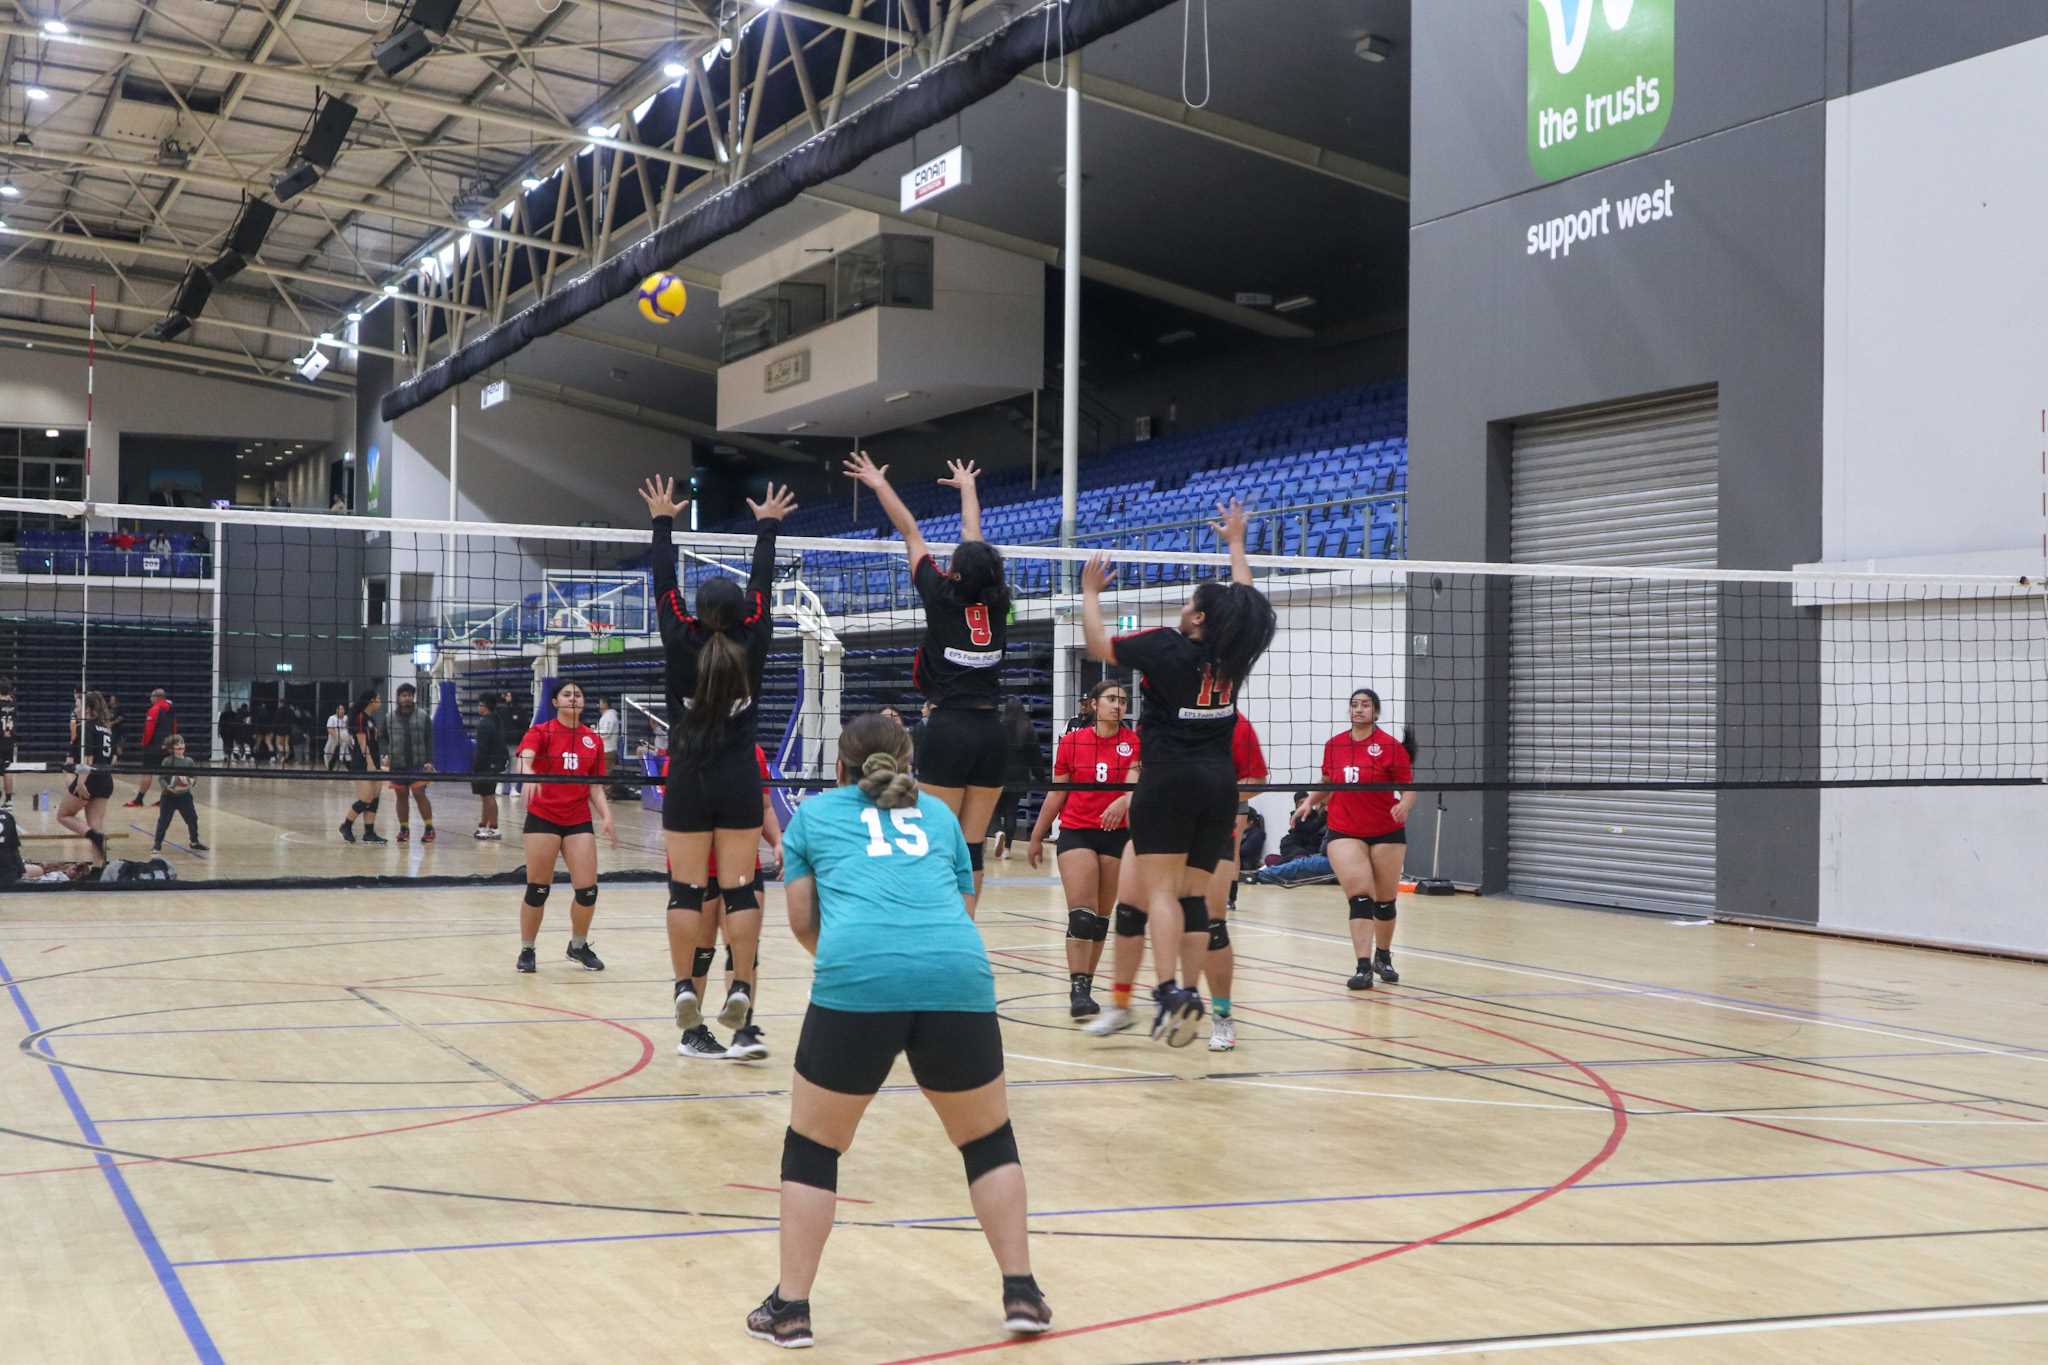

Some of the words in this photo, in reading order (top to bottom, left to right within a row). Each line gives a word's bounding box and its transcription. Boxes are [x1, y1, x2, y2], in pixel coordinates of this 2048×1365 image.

[1539, 107, 1578, 149] the
[1585, 75, 1660, 133] trusts
[1527, 198, 1611, 260] support
[1616, 179, 1675, 230] west
[965, 602, 992, 646] 9
[103, 734, 112, 757] 5
[1096, 762, 1108, 783] 8
[860, 807, 929, 857] 15
